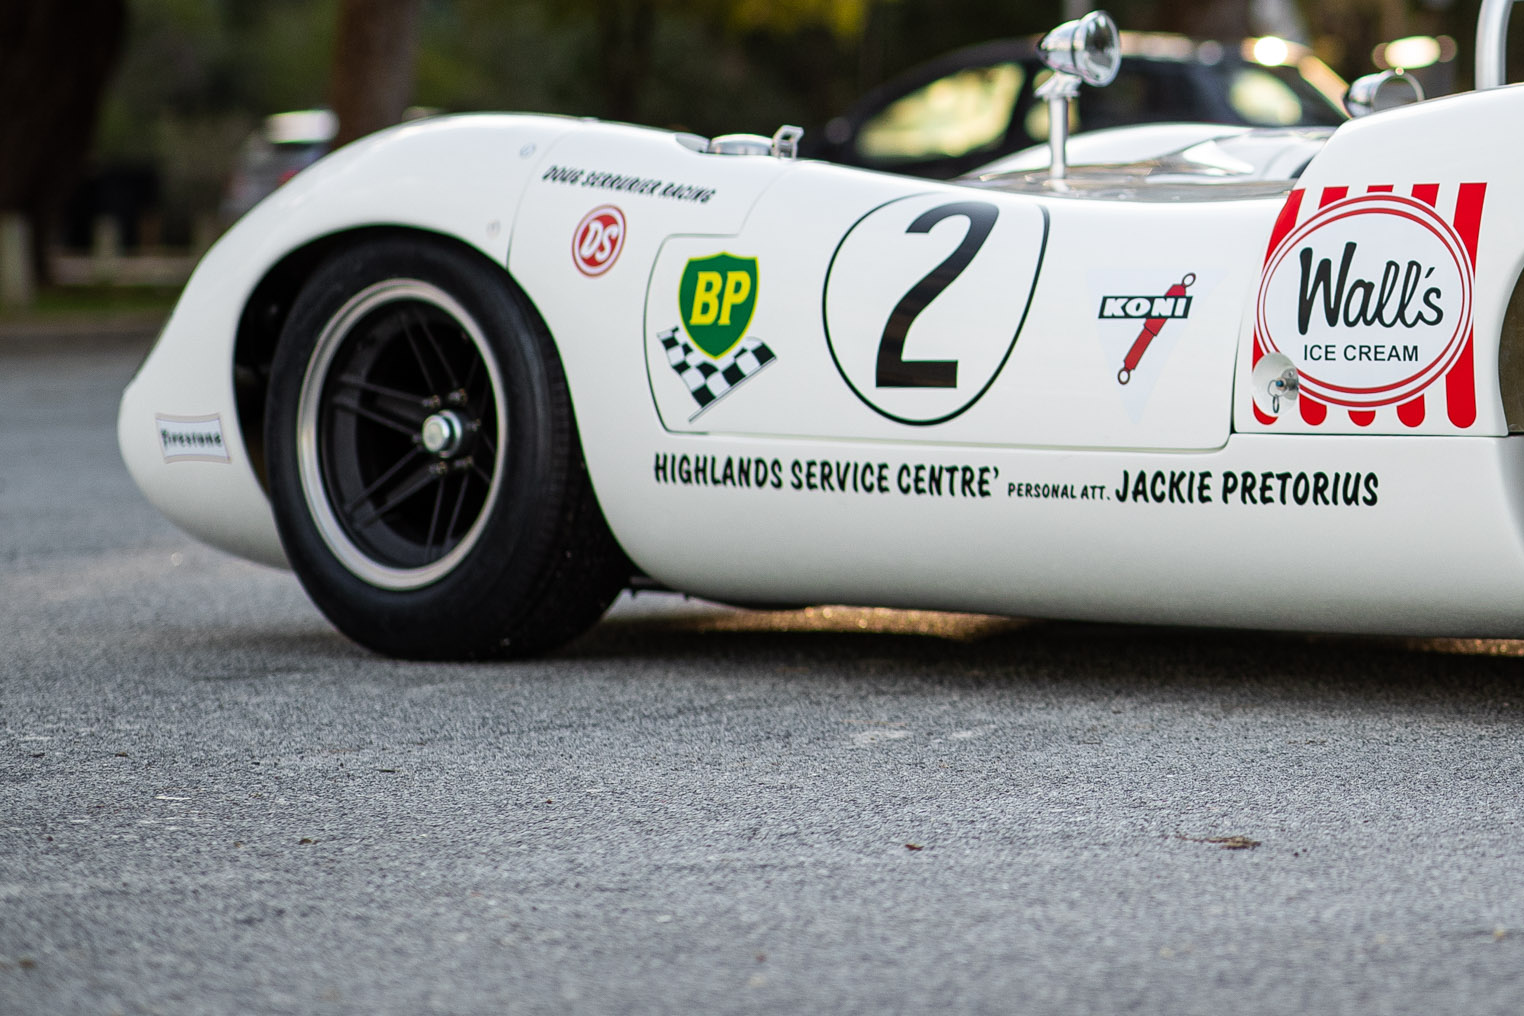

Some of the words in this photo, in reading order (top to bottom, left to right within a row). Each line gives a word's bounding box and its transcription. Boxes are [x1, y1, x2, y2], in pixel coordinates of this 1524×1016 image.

[542, 165, 585, 185] DOUG
[659, 183, 717, 204] RACING
[579, 219, 620, 263] DS
[689, 270, 751, 326] BP
[875, 200, 1000, 388] 2
[1101, 296, 1189, 318] KONI
[1297, 240, 1445, 336] Wall's
[1303, 344, 1337, 362] ICE
[1343, 344, 1419, 362] CREAM
[654, 452, 783, 490] HIGHLANDS
[790, 459, 891, 494] SERVICE
[1007, 482, 1077, 499] PERSONAL
[1080, 484, 1112, 501] ATT.
[1115, 469, 1213, 504] JACKIE
[1221, 470, 1380, 506] PRETORIUS
